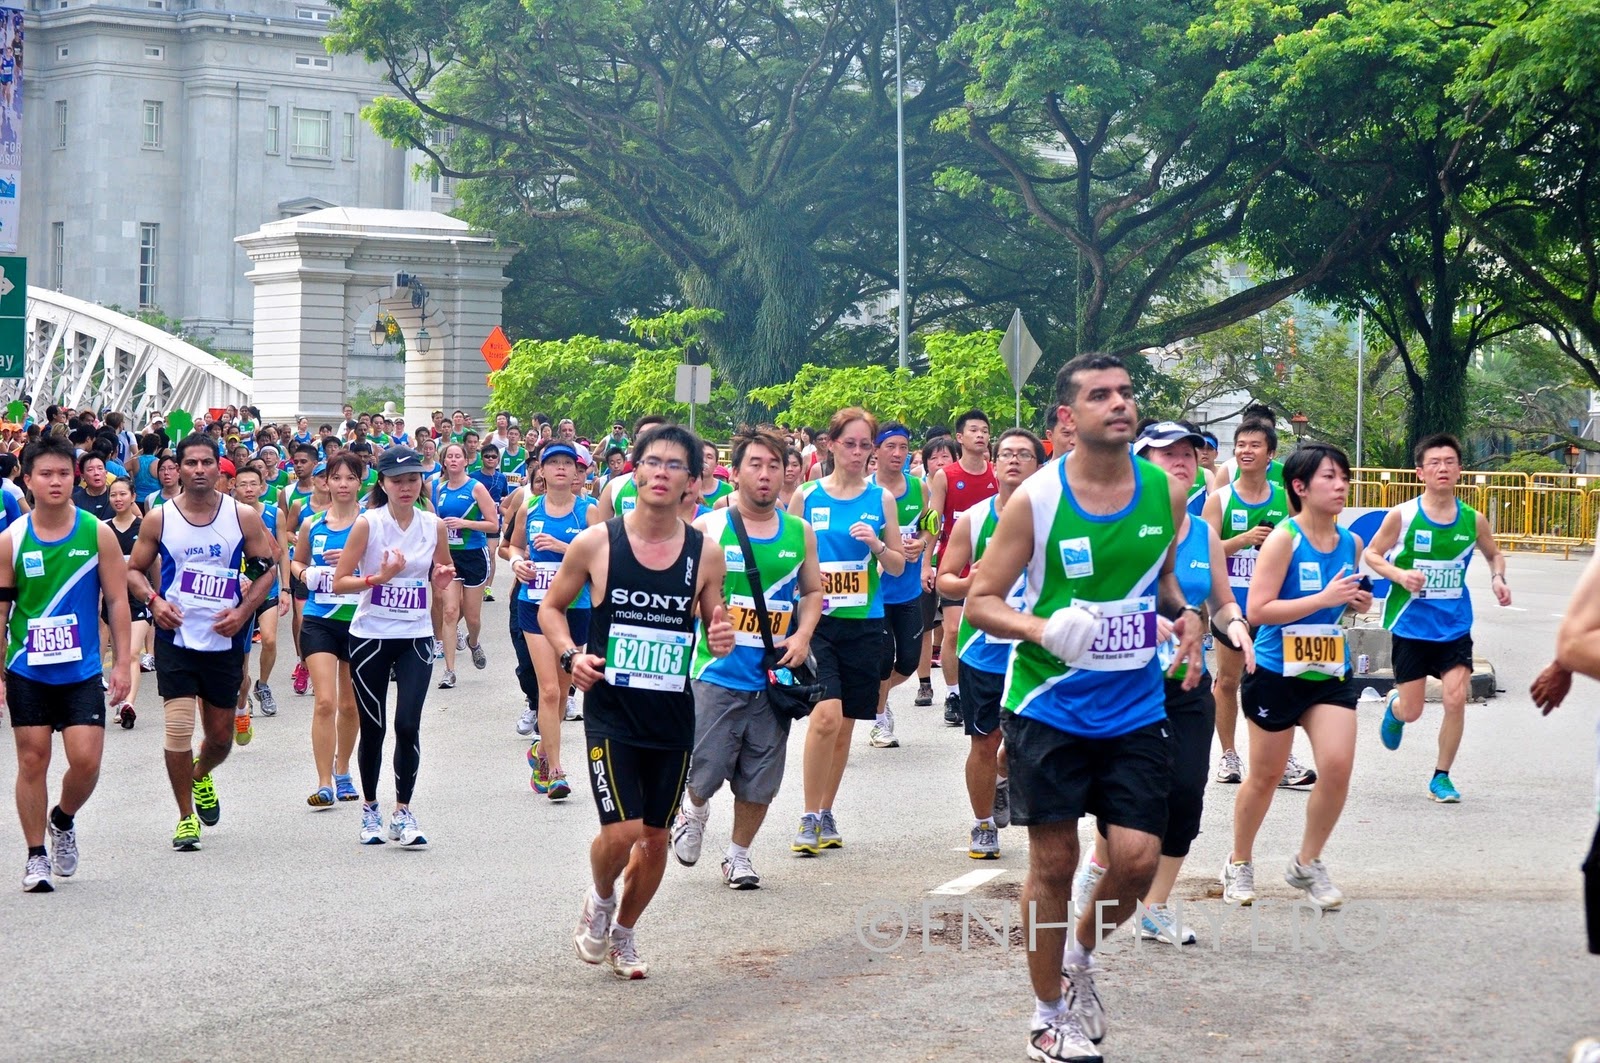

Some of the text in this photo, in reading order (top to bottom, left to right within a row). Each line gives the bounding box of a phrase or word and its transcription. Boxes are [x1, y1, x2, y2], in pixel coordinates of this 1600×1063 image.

[4, 142, 22, 153] FOR
[184, 547, 204, 556] VISA
[1232, 558, 1256, 576] 480
[191, 573, 228, 598] 41017
[824, 572, 860, 594] 3845
[380, 586, 420, 609] 53271
[611, 588, 691, 612] SONY
[615, 610, 683, 625] make.believe
[33, 625, 74, 652] 46595
[1092, 613, 1146, 652] 9353
[613, 638, 684, 675] 620163
[1294, 636, 1337, 662] 84970
[592, 759, 615, 813] SKINS
